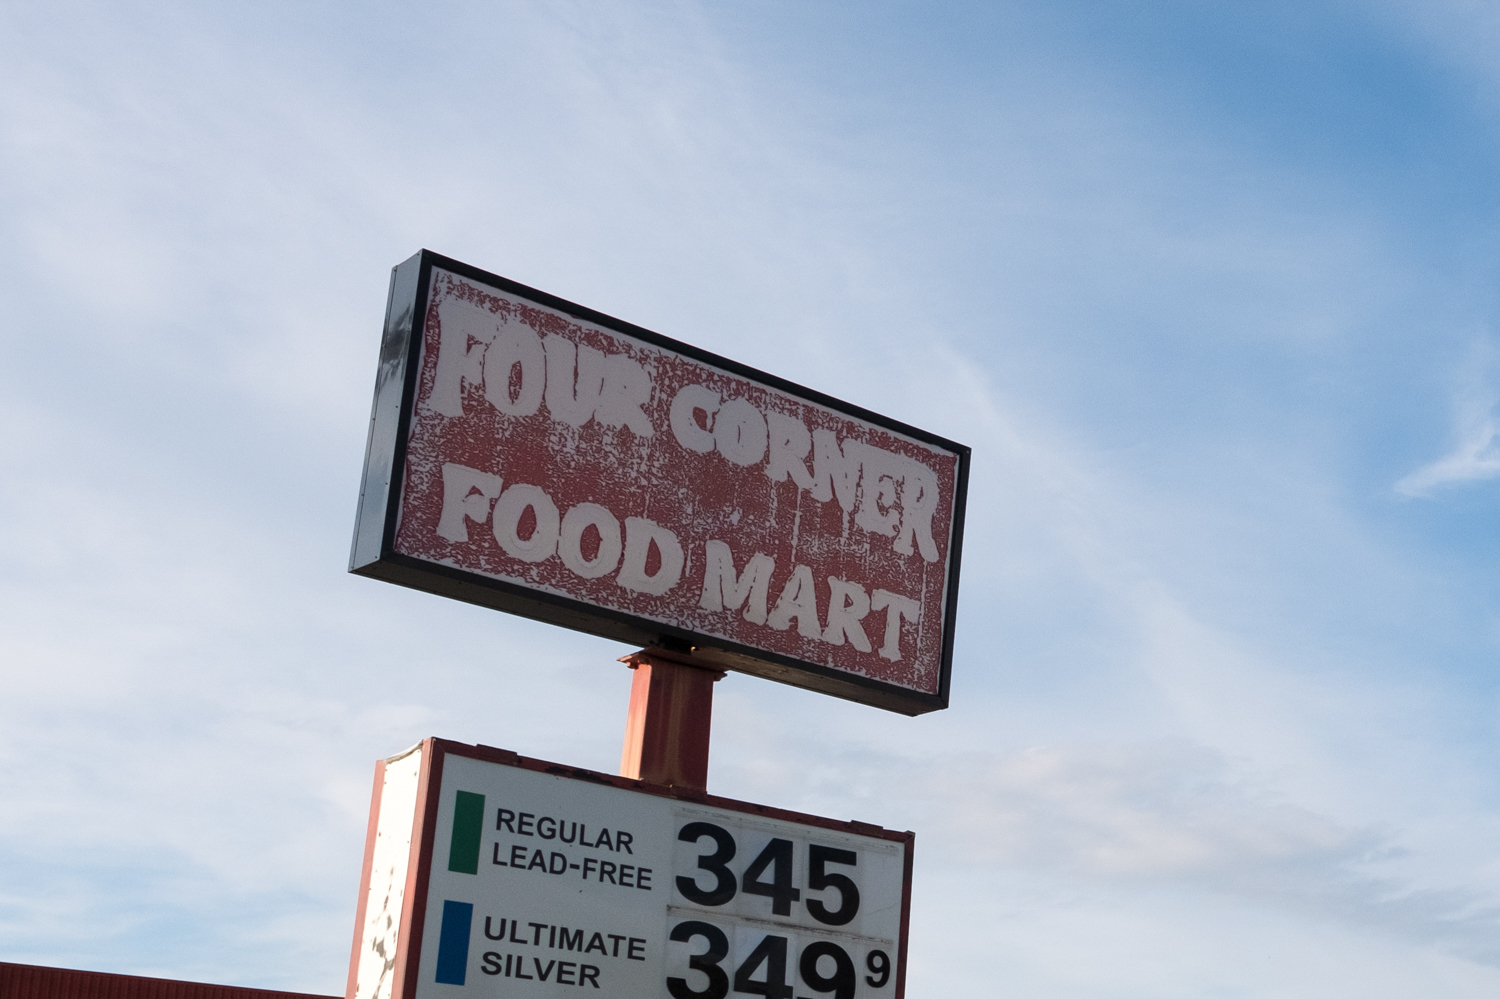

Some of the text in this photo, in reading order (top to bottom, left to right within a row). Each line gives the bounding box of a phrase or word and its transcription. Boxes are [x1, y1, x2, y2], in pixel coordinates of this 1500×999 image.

[430, 299, 940, 563] FOUR CORNER
[437, 462, 920, 662] FOOD MART
[495, 808, 635, 854] REGULAR
[492, 842, 653, 891] LEAD-FREE
[675, 821, 861, 927] 345
[483, 916, 647, 961] ULTIMATE
[480, 951, 602, 989] SILVER
[865, 949, 891, 988] 9
